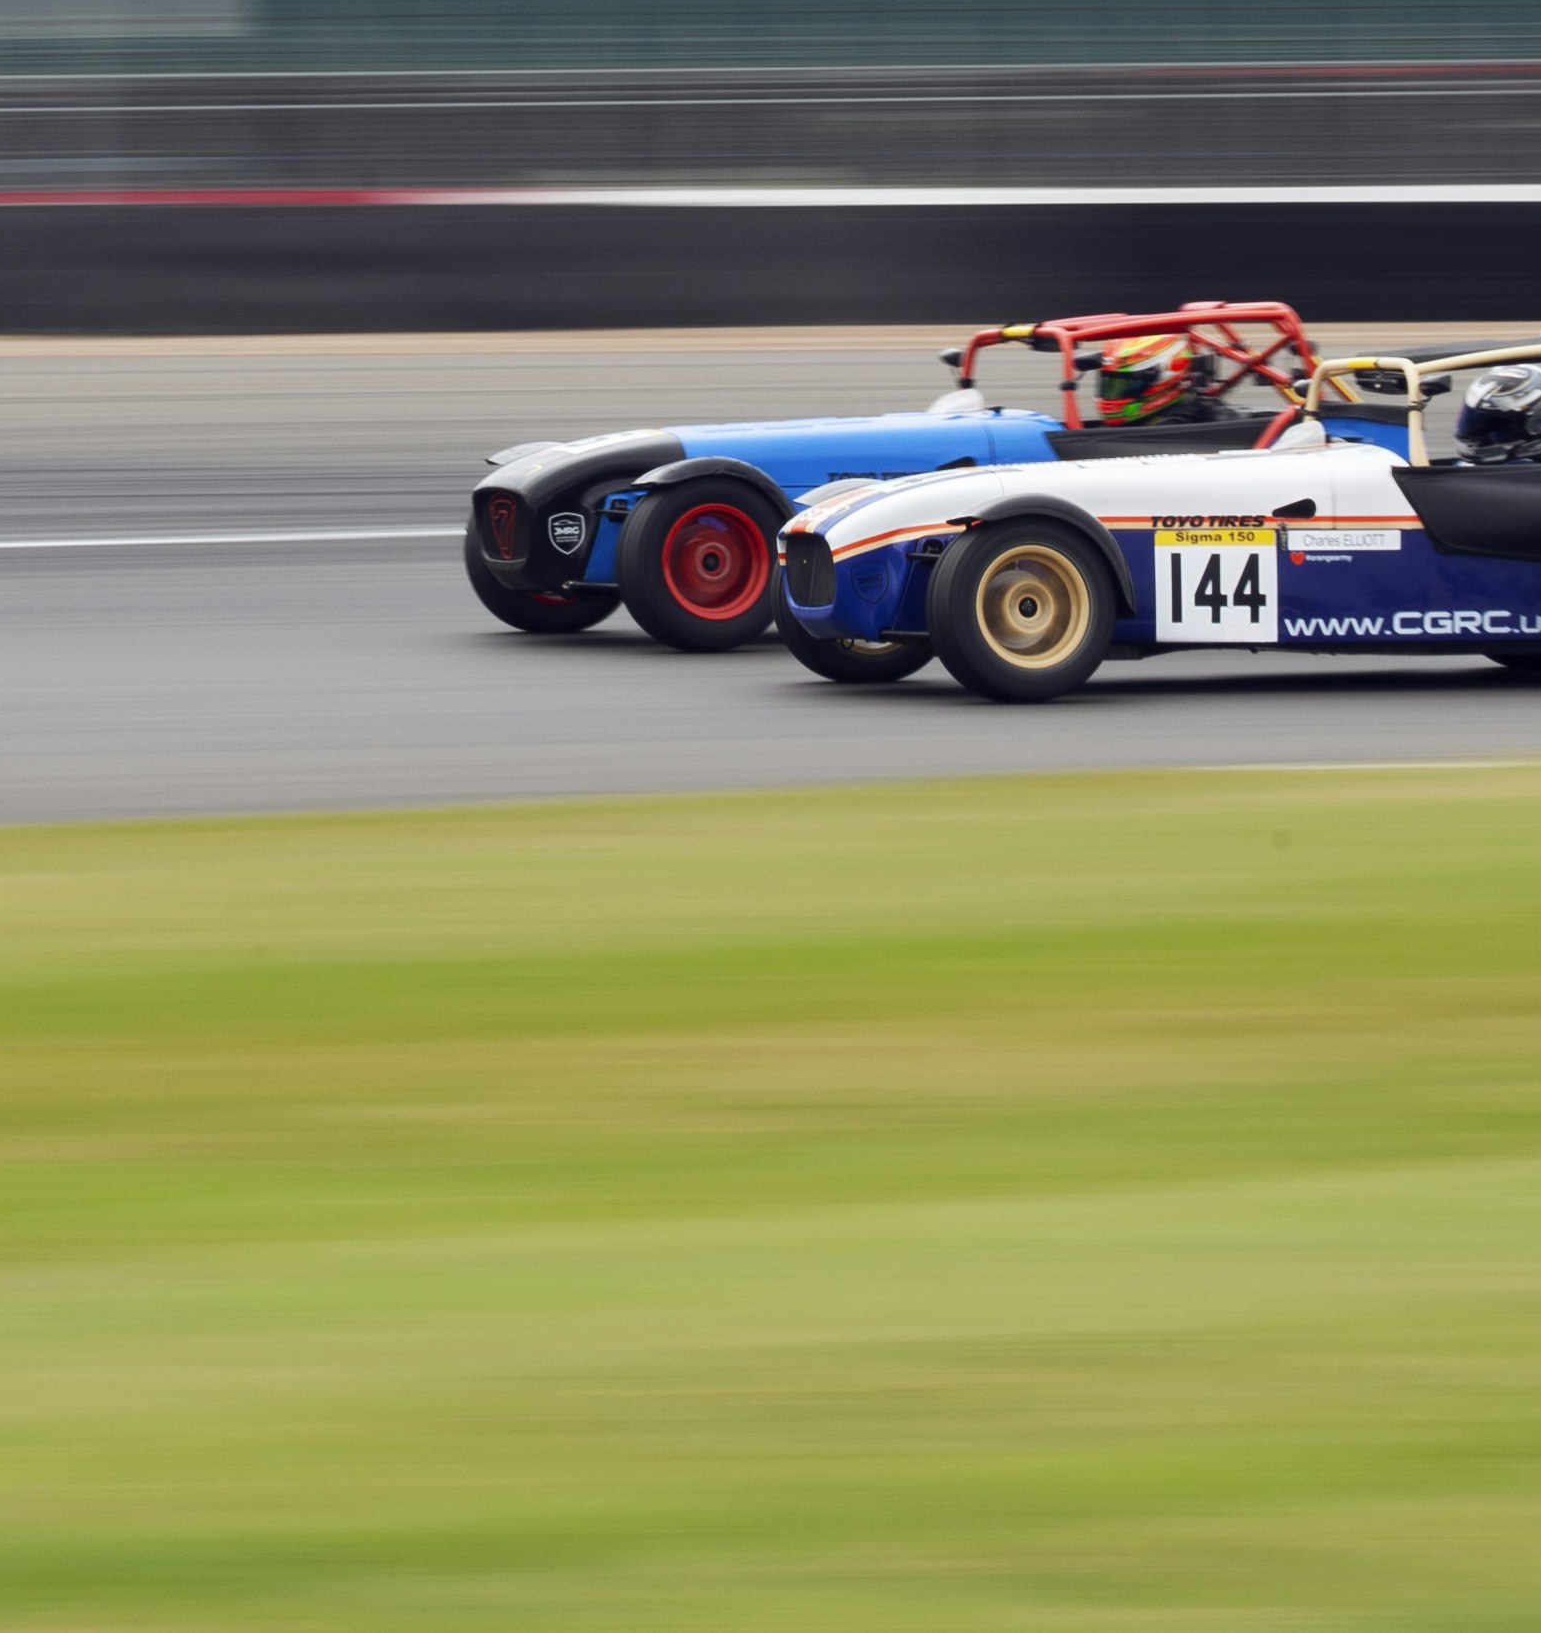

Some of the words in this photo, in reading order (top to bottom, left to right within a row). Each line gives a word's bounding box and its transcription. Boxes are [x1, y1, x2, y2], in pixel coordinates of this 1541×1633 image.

[1151, 515, 1204, 527] TOYO
[1209, 515, 1266, 527] TIRES
[1175, 531, 1222, 544] Sigma
[1229, 531, 1255, 541] 150
[1303, 534, 1341, 547] Charles
[1342, 533, 1385, 546] ELLIOTT
[1171, 553, 1267, 624] 144
